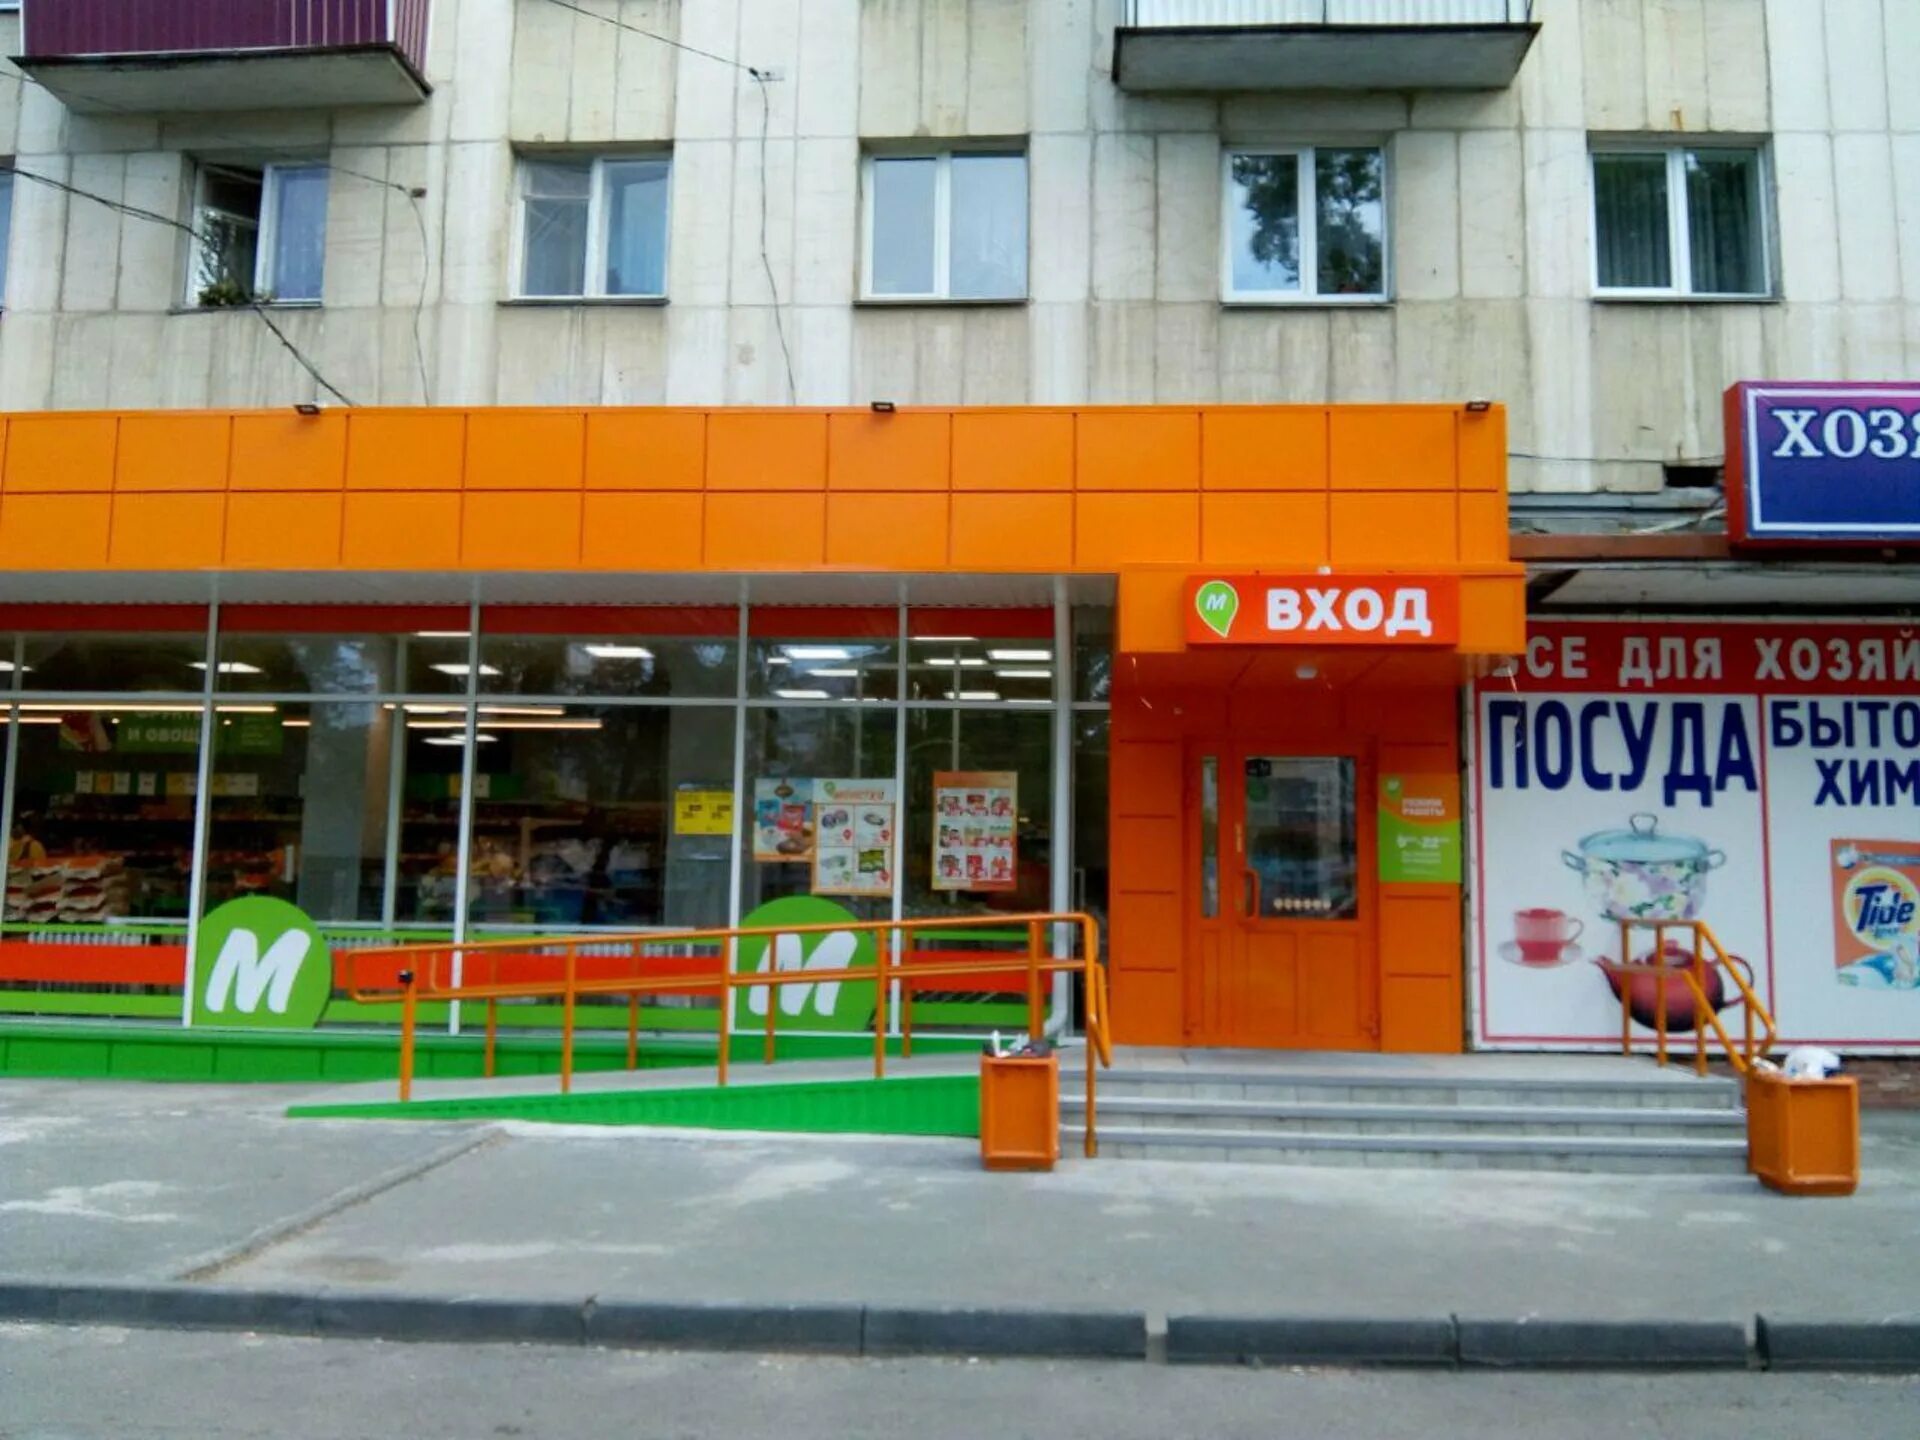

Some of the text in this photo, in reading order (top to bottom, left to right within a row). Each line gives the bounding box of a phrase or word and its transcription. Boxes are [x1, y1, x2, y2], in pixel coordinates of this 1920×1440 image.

[1772, 407, 1920, 459] ХОЗ
[1266, 588, 1433, 638] ВХОД
[1617, 636, 1722, 688] ДЛЯ
[1754, 628, 1920, 682] ХОЗЯЙ
[1771, 700, 1920, 749] БЫТО
[1488, 699, 1759, 807] ПОСУДА
[1814, 759, 1920, 807] ХИМ
[1855, 884, 1915, 933] Tide
